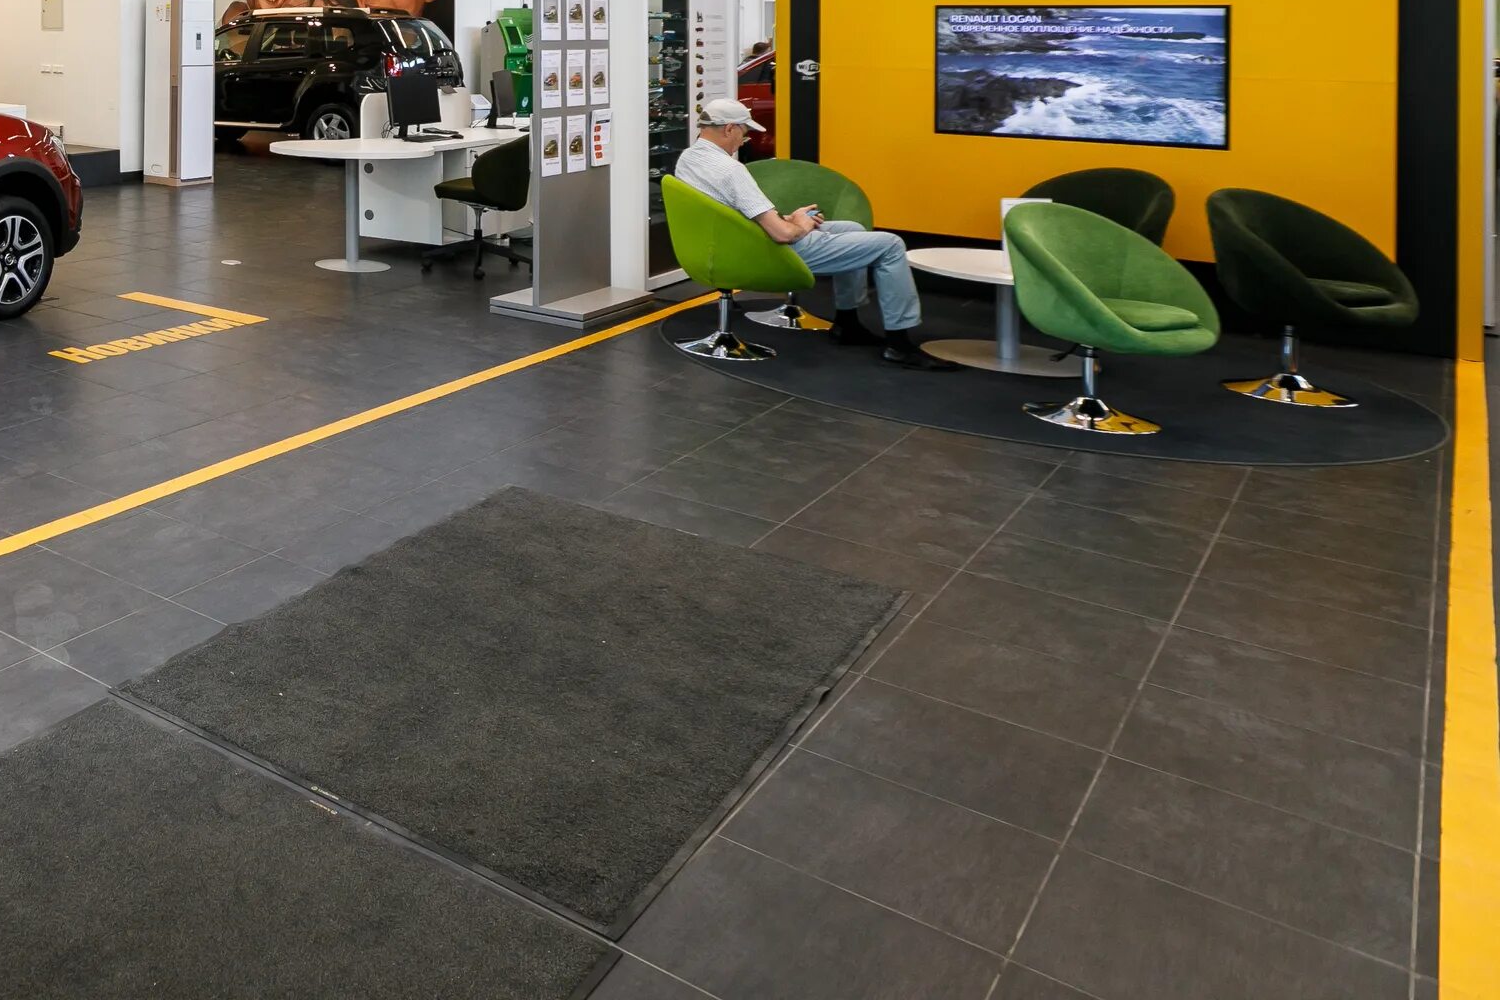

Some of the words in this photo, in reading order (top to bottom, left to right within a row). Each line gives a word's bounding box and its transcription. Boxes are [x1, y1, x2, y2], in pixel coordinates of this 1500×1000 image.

[951, 14, 1000, 24] RENAULT
[1002, 15, 1042, 24] LOGAN
[951, 24, 1021, 33] СОВРЕМЕННОЕ
[1022, 25, 1096, 33] ВОПЛОЩЕНИЕ
